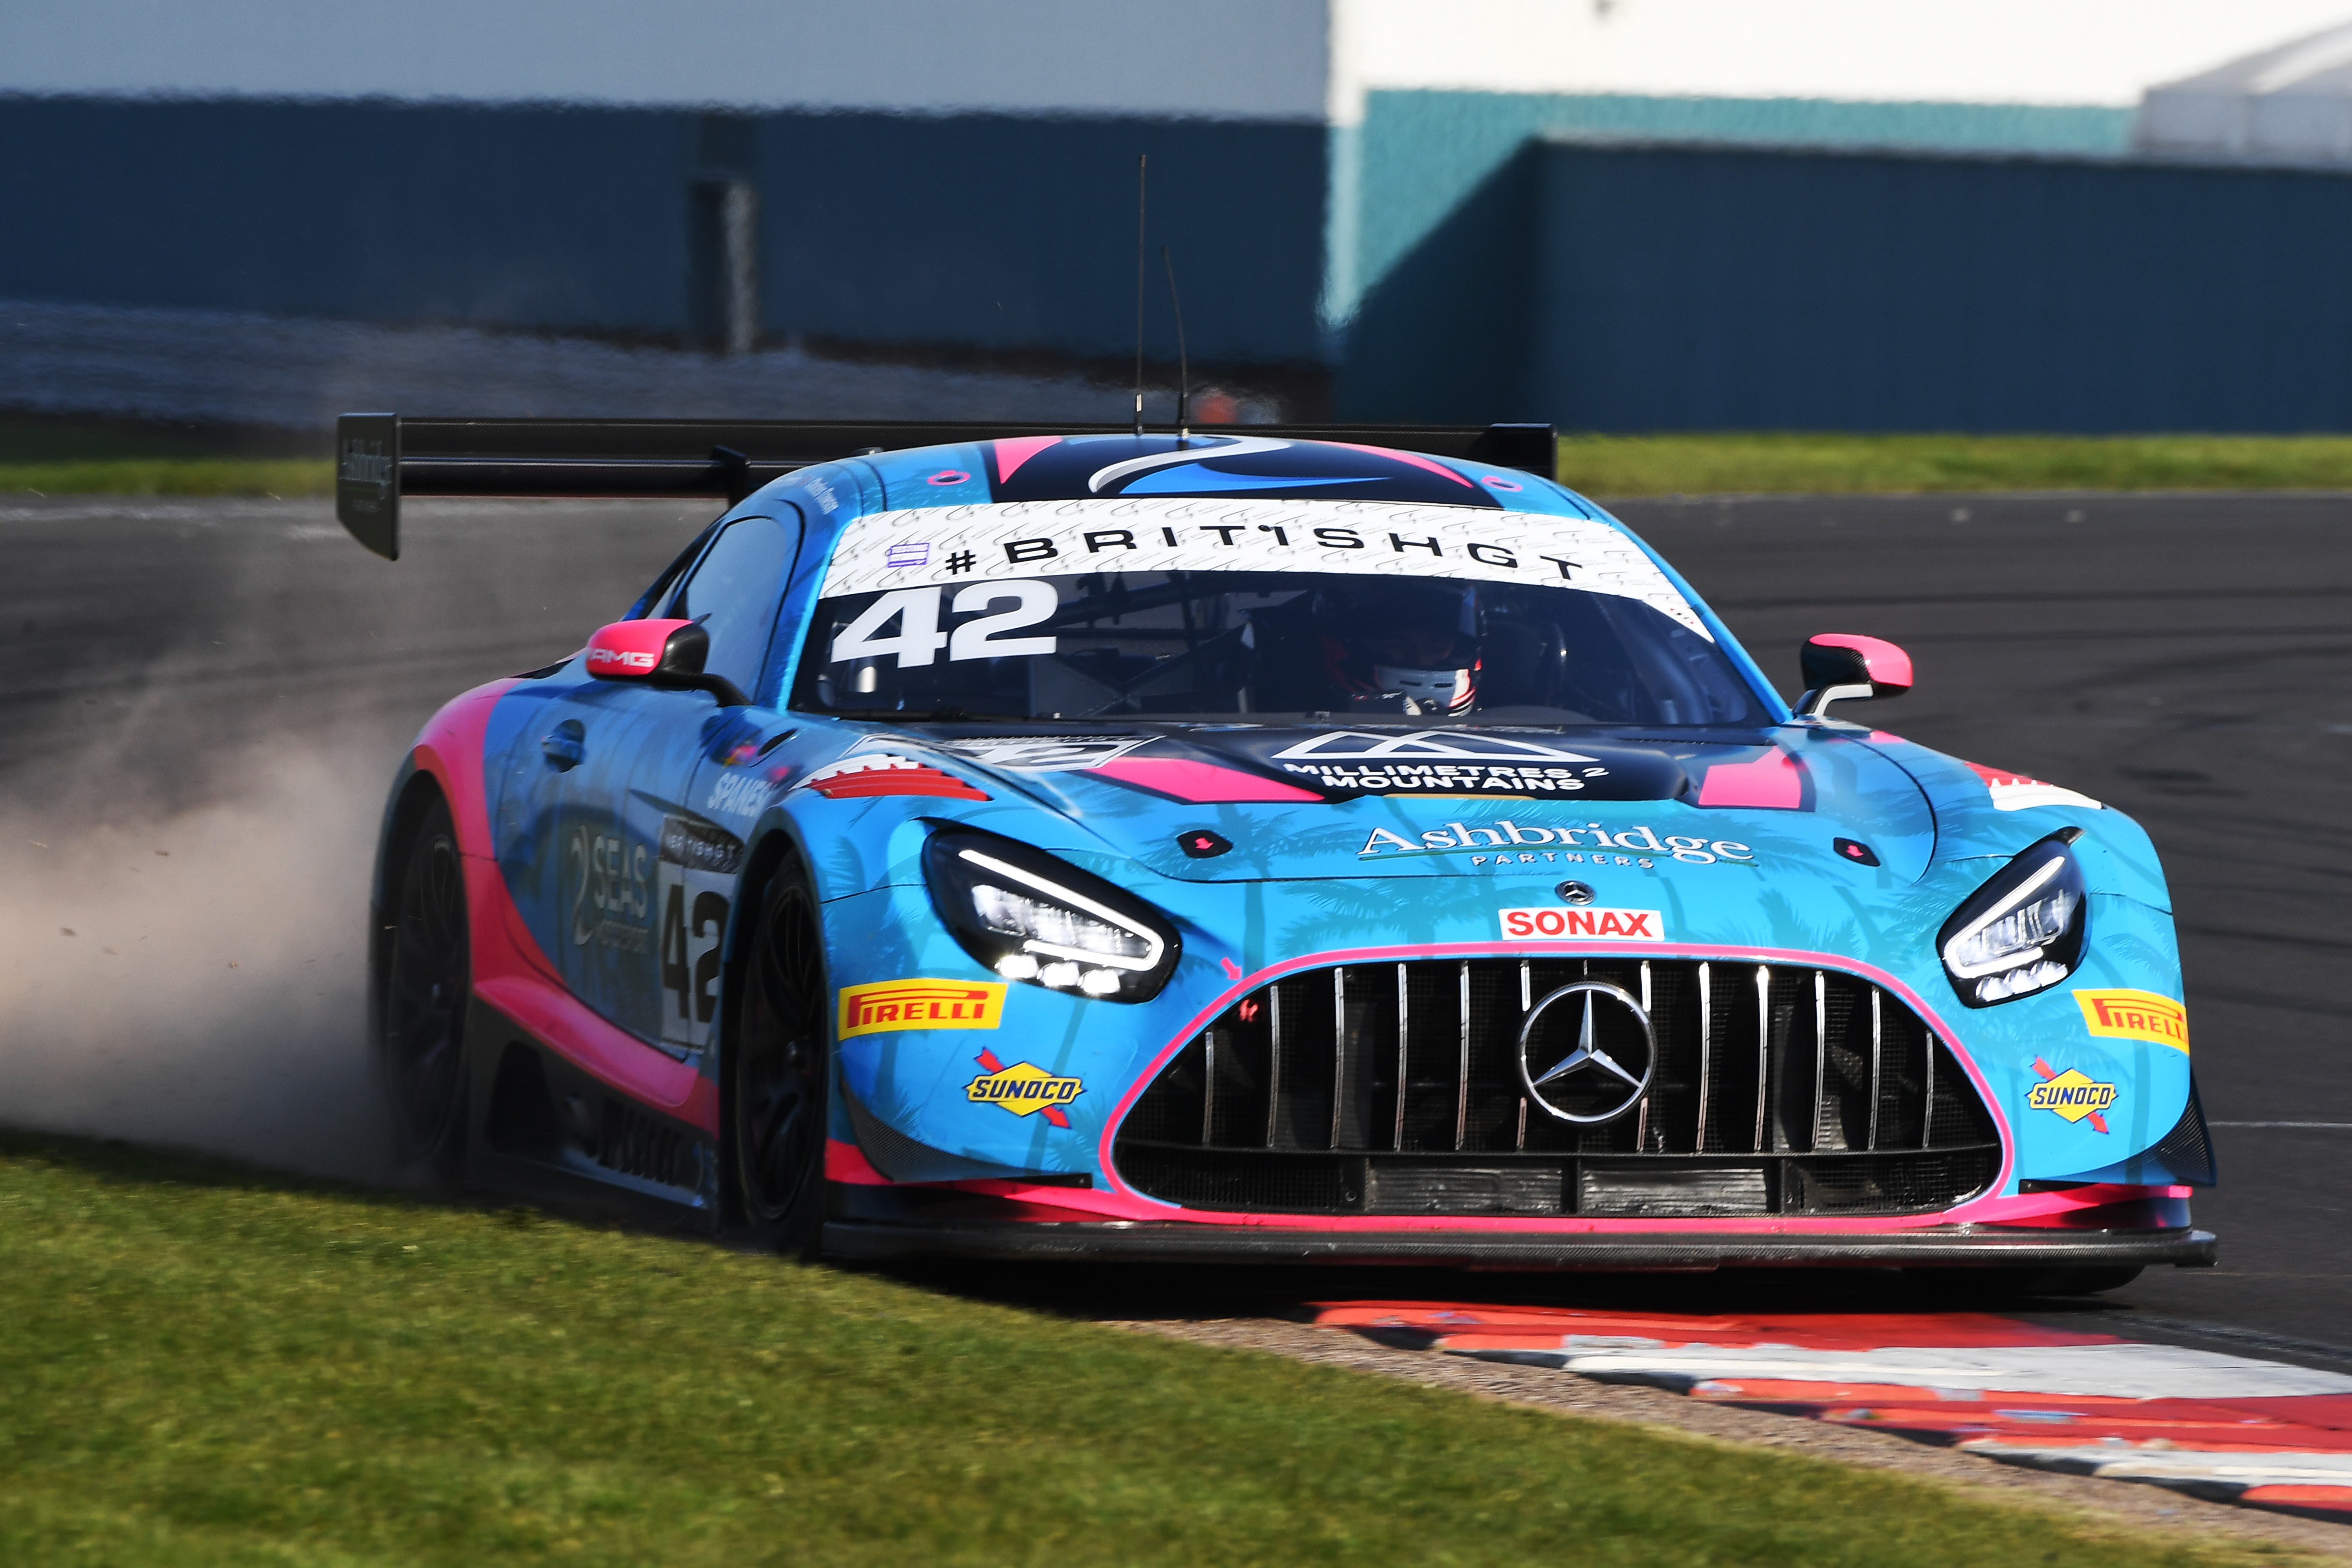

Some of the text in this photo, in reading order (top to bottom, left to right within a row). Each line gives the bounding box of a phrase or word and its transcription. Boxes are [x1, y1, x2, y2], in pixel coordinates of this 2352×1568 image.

[946, 525, 1582, 580] #BRITISHGT
[831, 579, 1058, 668] 42
[1283, 763, 1610, 779] MILLIMETRES 2
[1321, 776, 1585, 790] MOUNTAINS
[1357, 820, 1753, 864] Ashbridge
[1471, 853, 1654, 868] PARTNERS
[593, 835, 648, 920] SEAS
[1507, 911, 1652, 937] SONAX
[661, 884, 731, 1024] 42
[848, 988, 988, 1029] PIRELLI
[973, 1079, 1076, 1100] SUNOCO
[2034, 1087, 2111, 1105] SUNOCO
